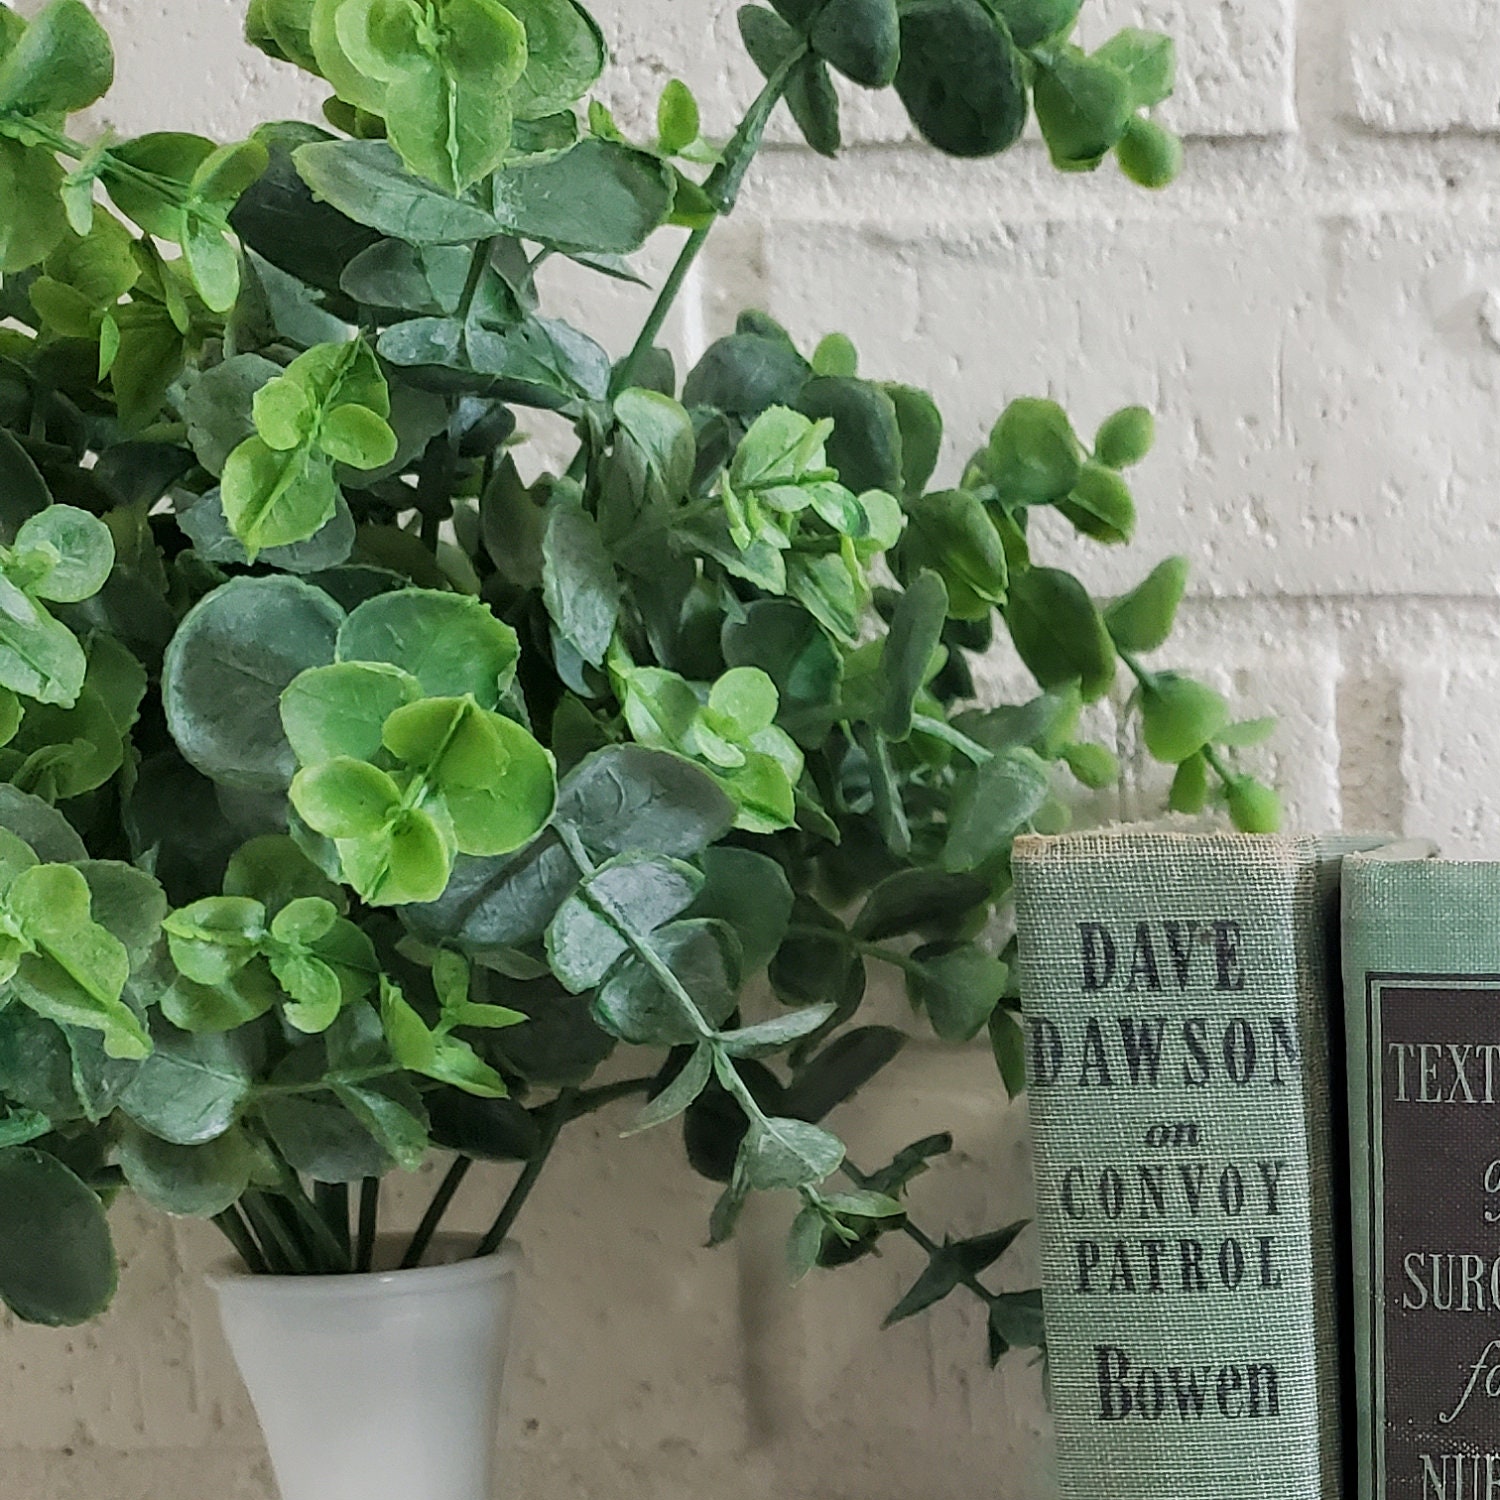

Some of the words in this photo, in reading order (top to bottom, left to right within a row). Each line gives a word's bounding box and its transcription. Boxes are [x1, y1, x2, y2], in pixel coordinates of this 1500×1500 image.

[1077, 921, 1244, 991] DAVE
[1026, 1017, 1300, 1086] DAWSON
[1146, 1122, 1200, 1146] on
[1062, 1162, 1285, 1220] CONVOY
[1074, 1238, 1282, 1293] PATROL
[1095, 1344, 1280, 1420] Bowen
